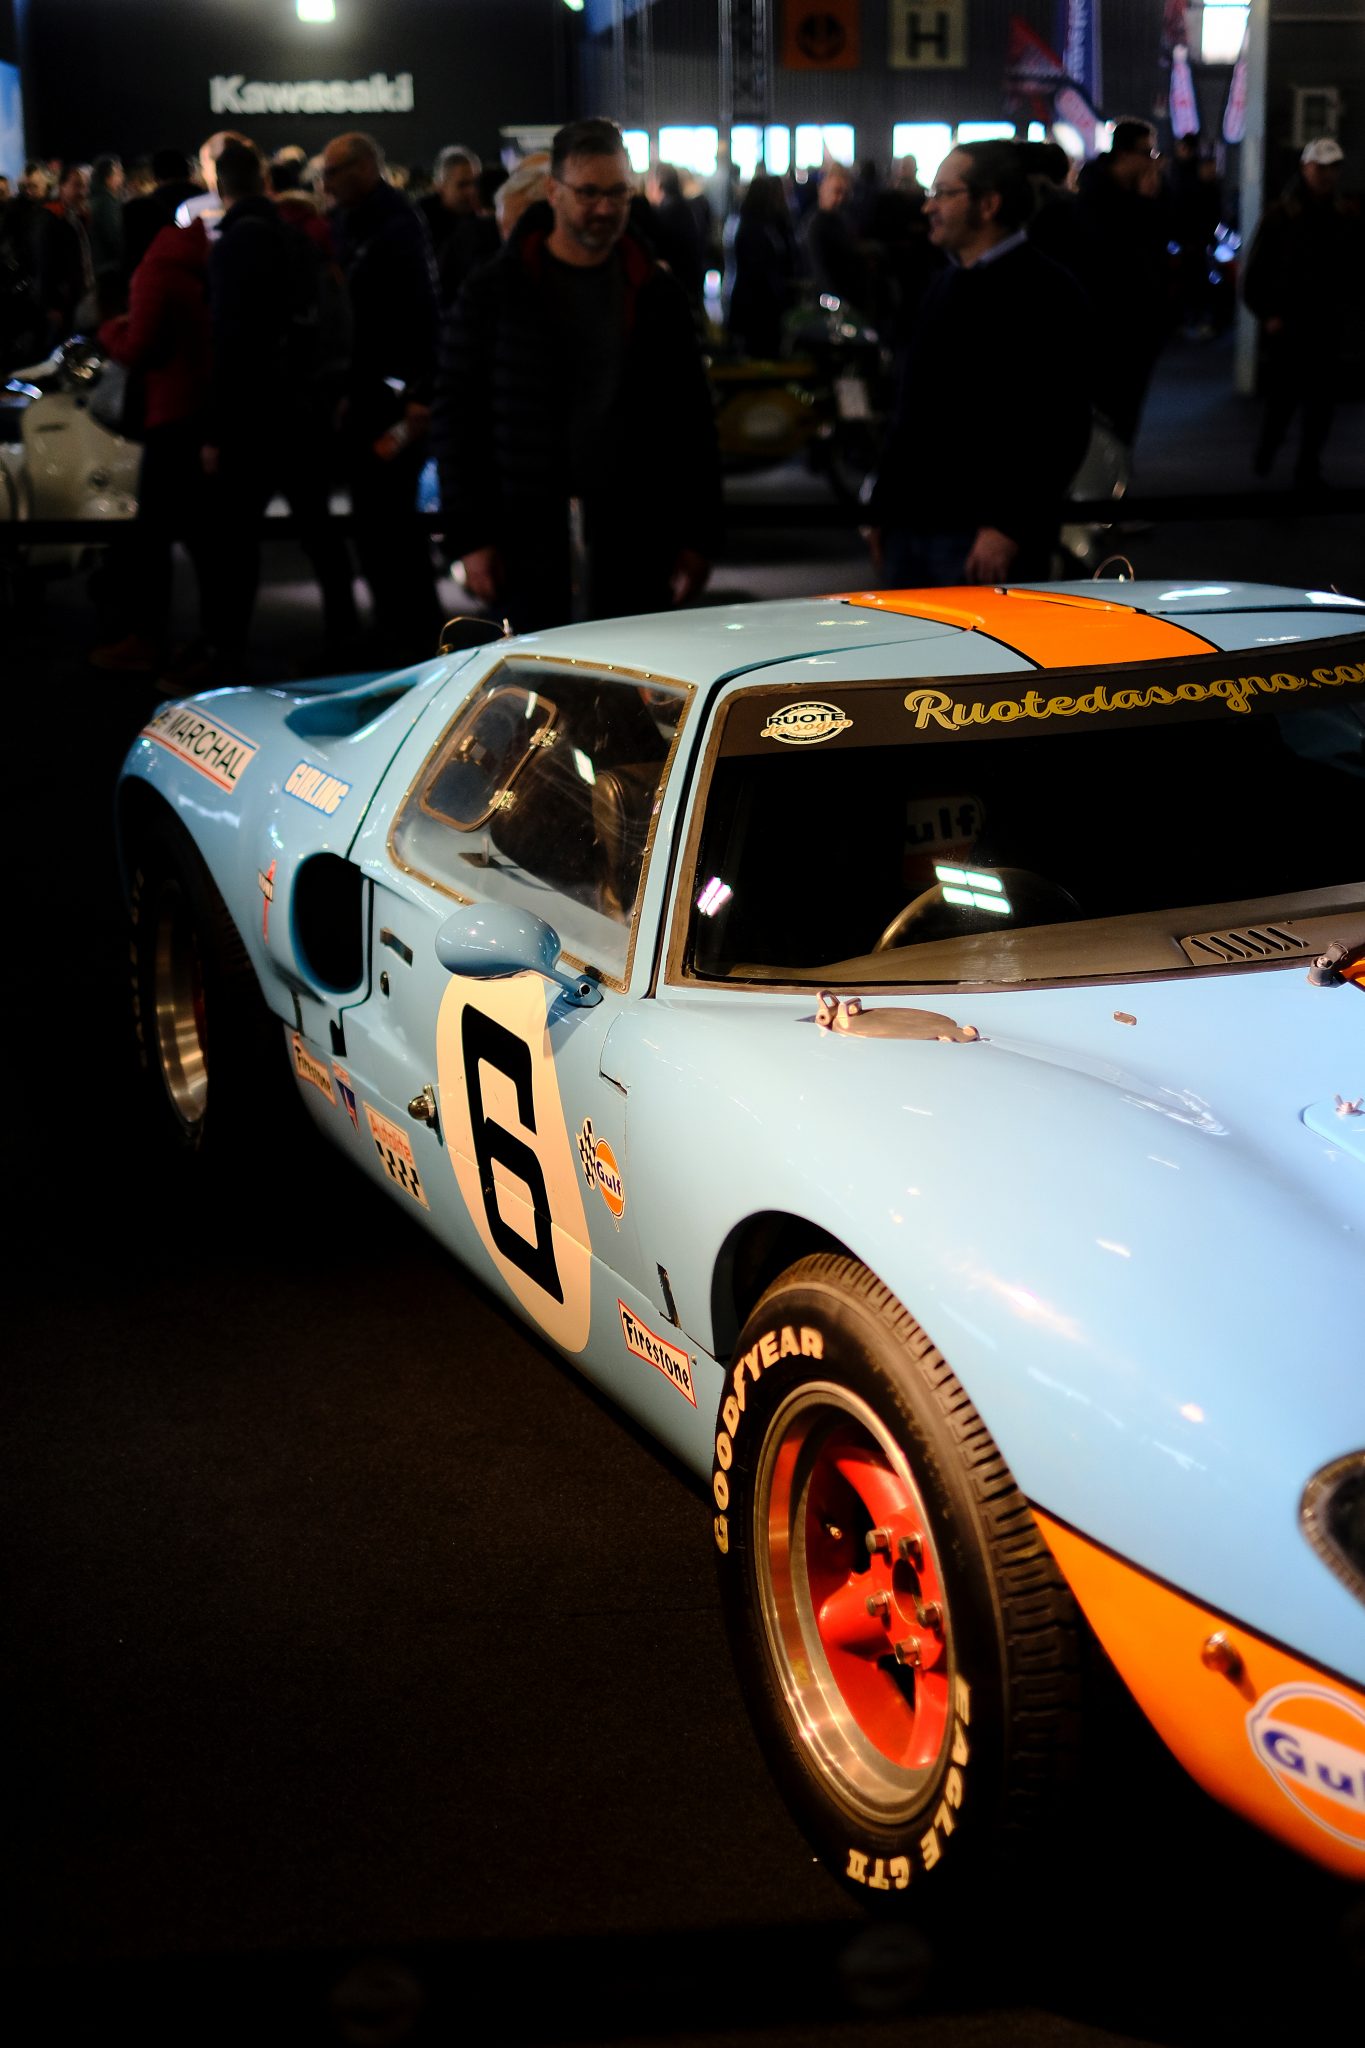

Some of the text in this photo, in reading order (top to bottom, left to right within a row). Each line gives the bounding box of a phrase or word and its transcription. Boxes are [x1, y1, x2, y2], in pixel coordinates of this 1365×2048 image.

[907, 11, 949, 60] H
[209, 72, 414, 114] Kawasaki
[761, 719, 853, 737] da sogno
[768, 713, 844, 727] RUOTE
[167, 713, 245, 781] MARCHAL
[284, 762, 350, 815] GIRLING
[904, 804, 975, 844] ulf
[460, 1003, 565, 1305] 6
[596, 1160, 622, 1198] Gulf
[622, 1311, 690, 1391] Firestone
[713, 1325, 825, 1555] GOODYEAR
[920, 1673, 971, 1872] EAGLE
